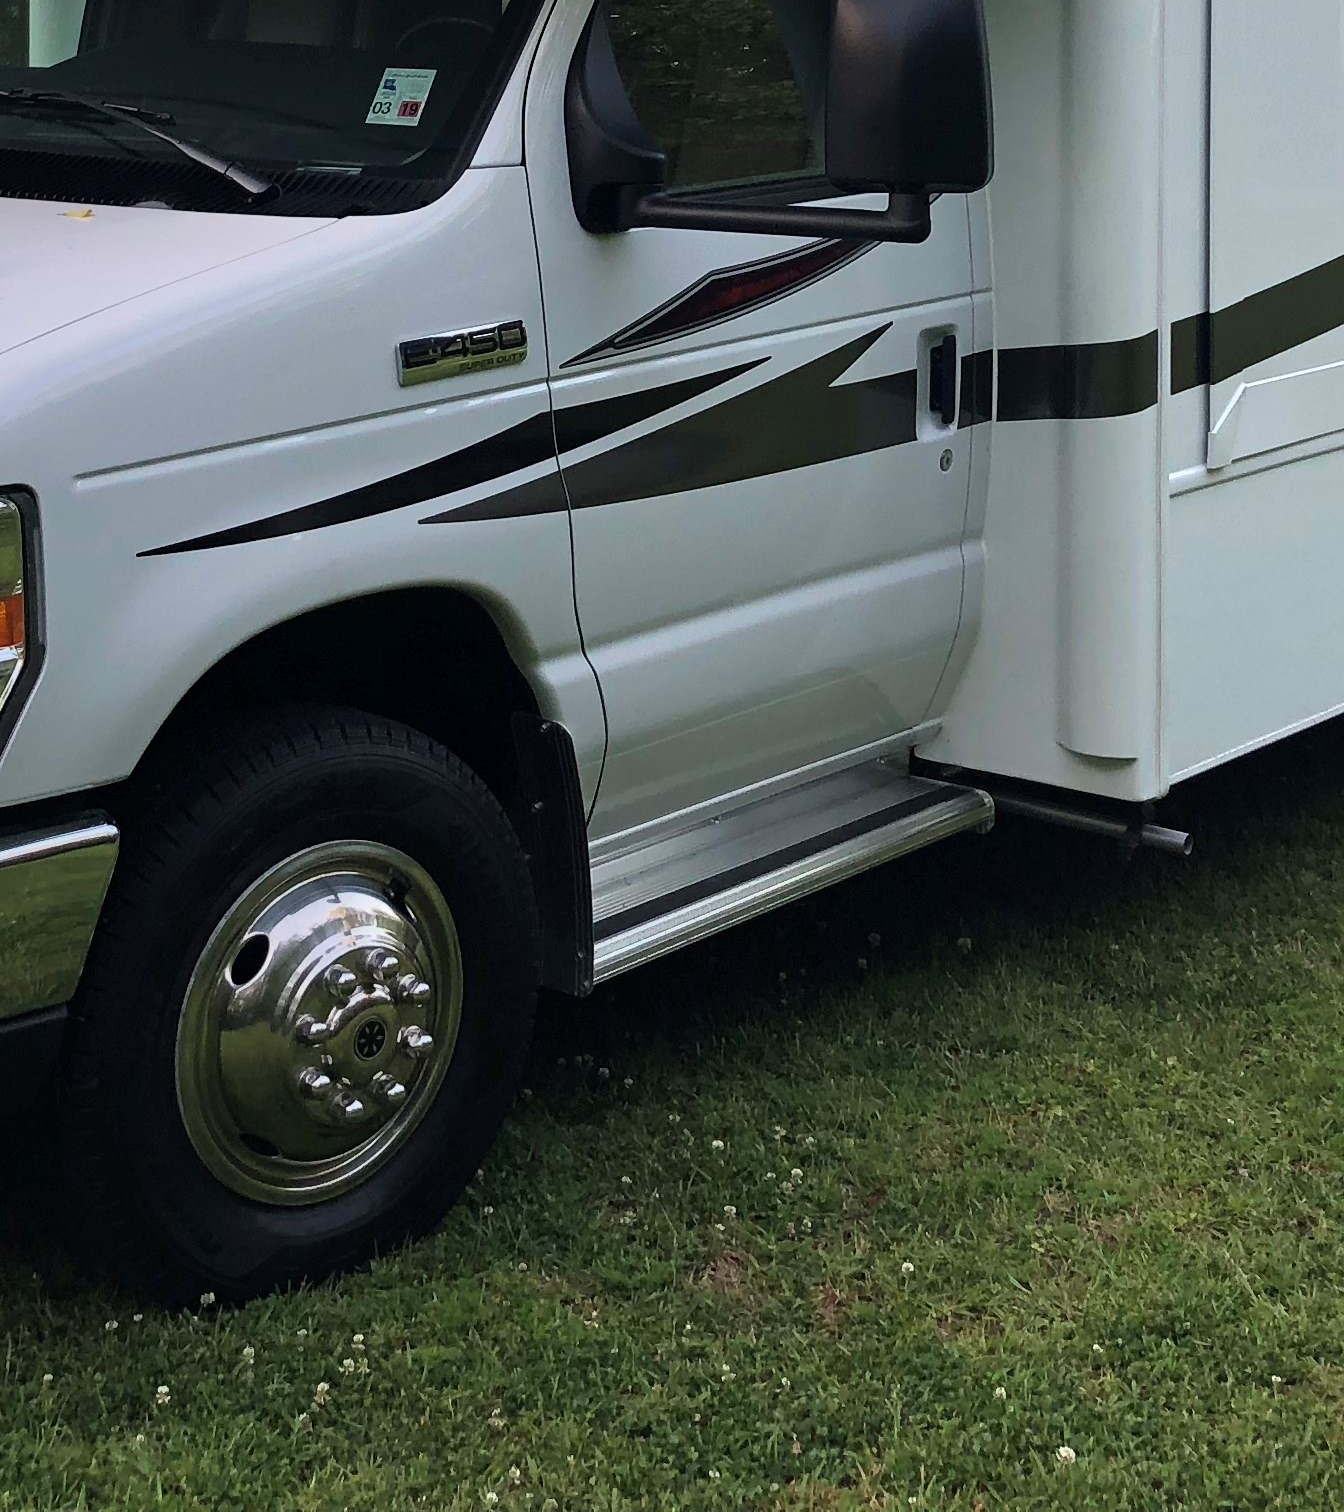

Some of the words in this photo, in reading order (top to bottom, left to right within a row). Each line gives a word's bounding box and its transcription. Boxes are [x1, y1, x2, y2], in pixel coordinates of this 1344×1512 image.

[372, 101, 392, 115] 03
[401, 102, 419, 116] 19
[460, 358, 494, 370] SUPER
[496, 351, 525, 364] DUTY
